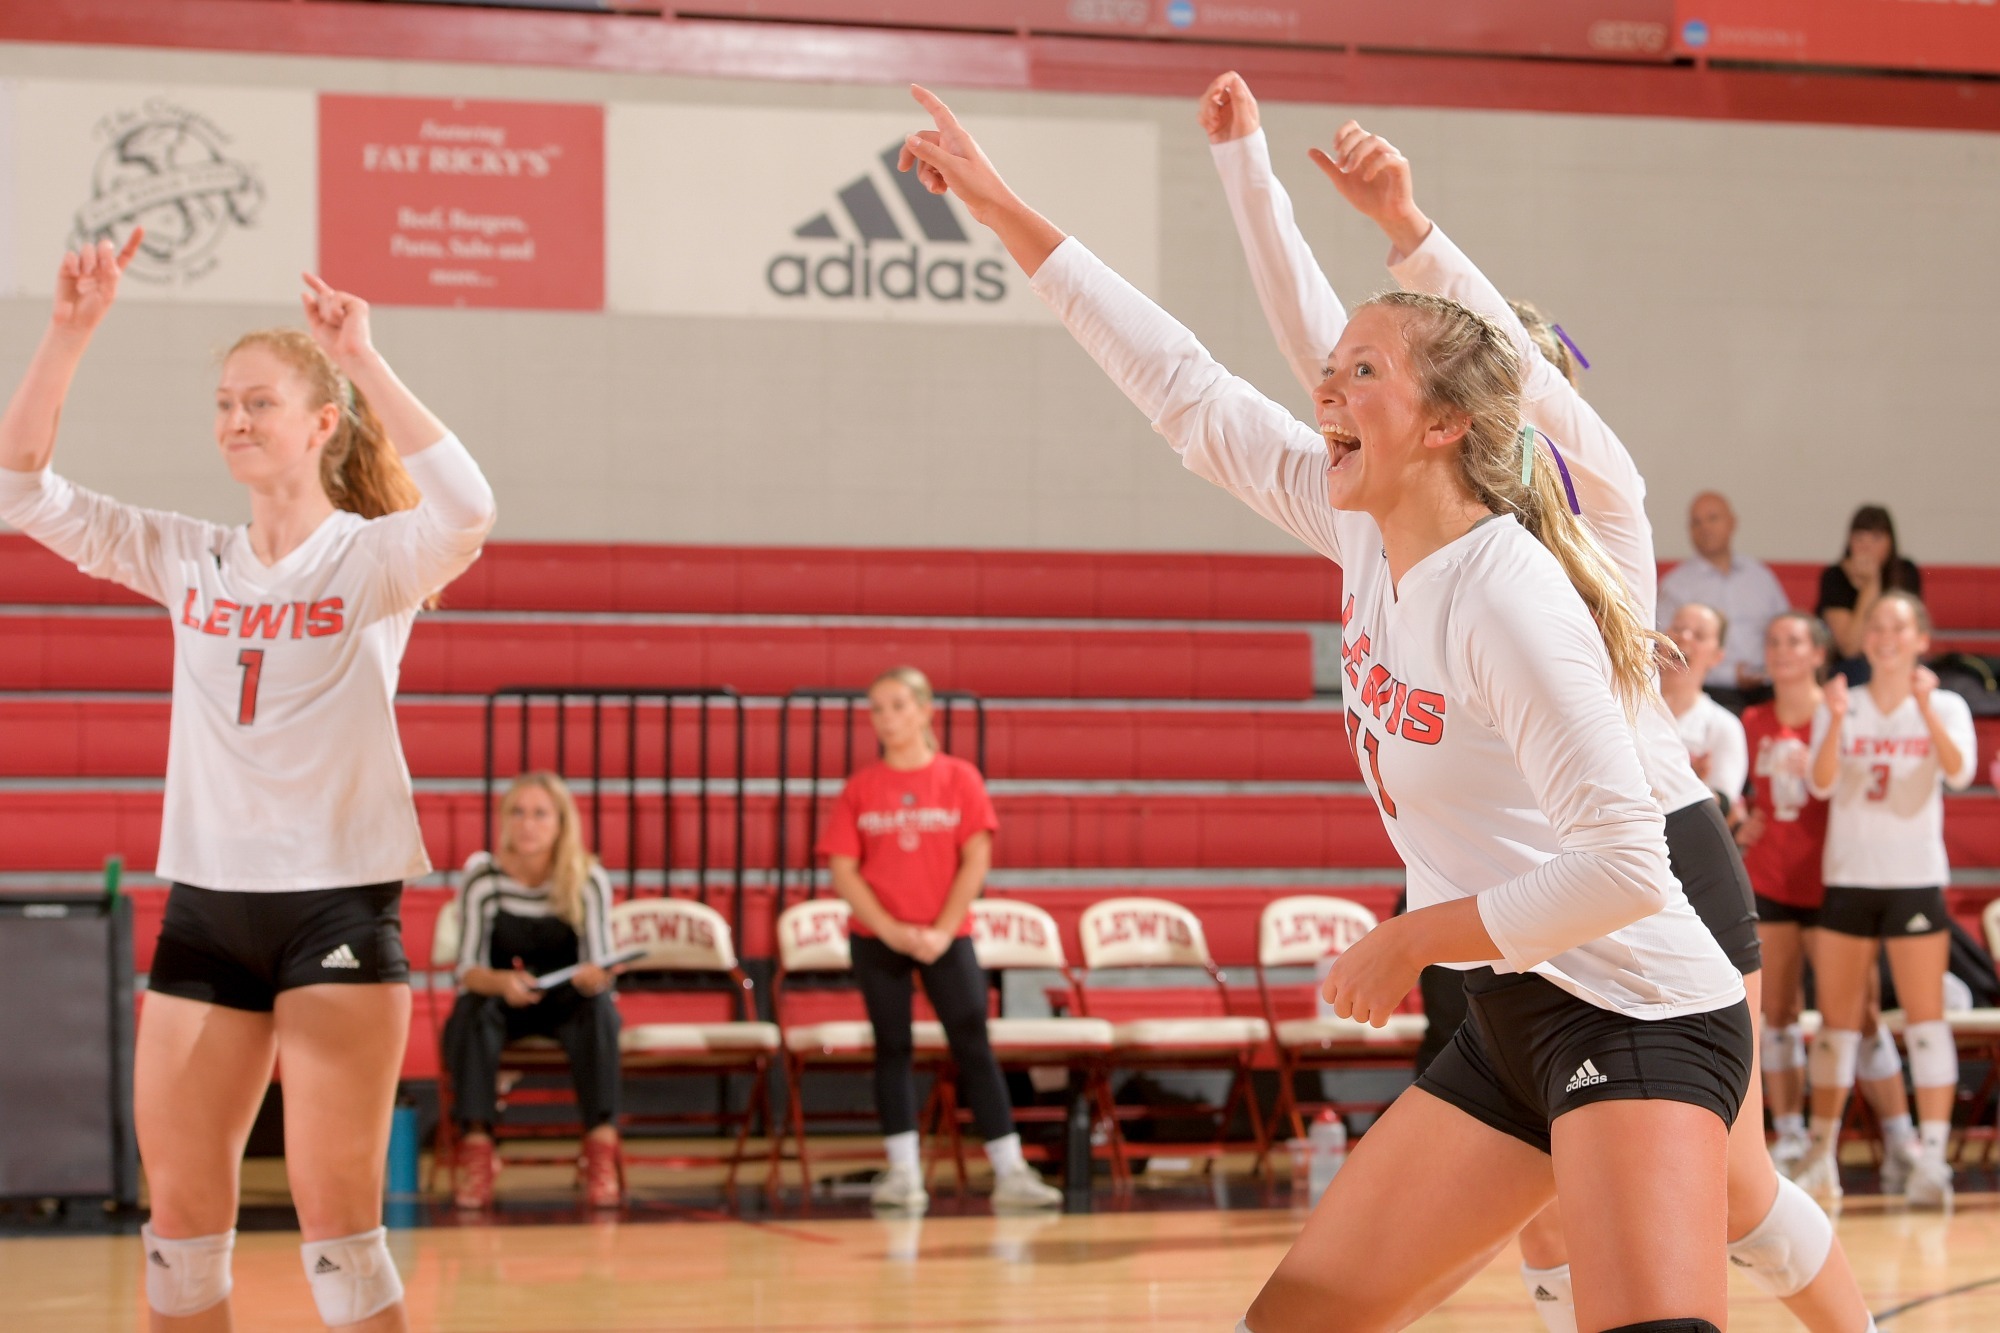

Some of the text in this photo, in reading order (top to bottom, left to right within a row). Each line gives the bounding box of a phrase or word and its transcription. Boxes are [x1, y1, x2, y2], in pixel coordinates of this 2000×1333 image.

[362, 143, 422, 172] FAT
[766, 243, 1008, 303] adidas
[182, 588, 344, 639] LEWIS
[237, 648, 264, 726] 1
[1866, 764, 1890, 801] 3
[612, 912, 715, 949] LEWIS
[1094, 911, 1192, 948] LEWIS
[1565, 1074, 1607, 1092] adidas
